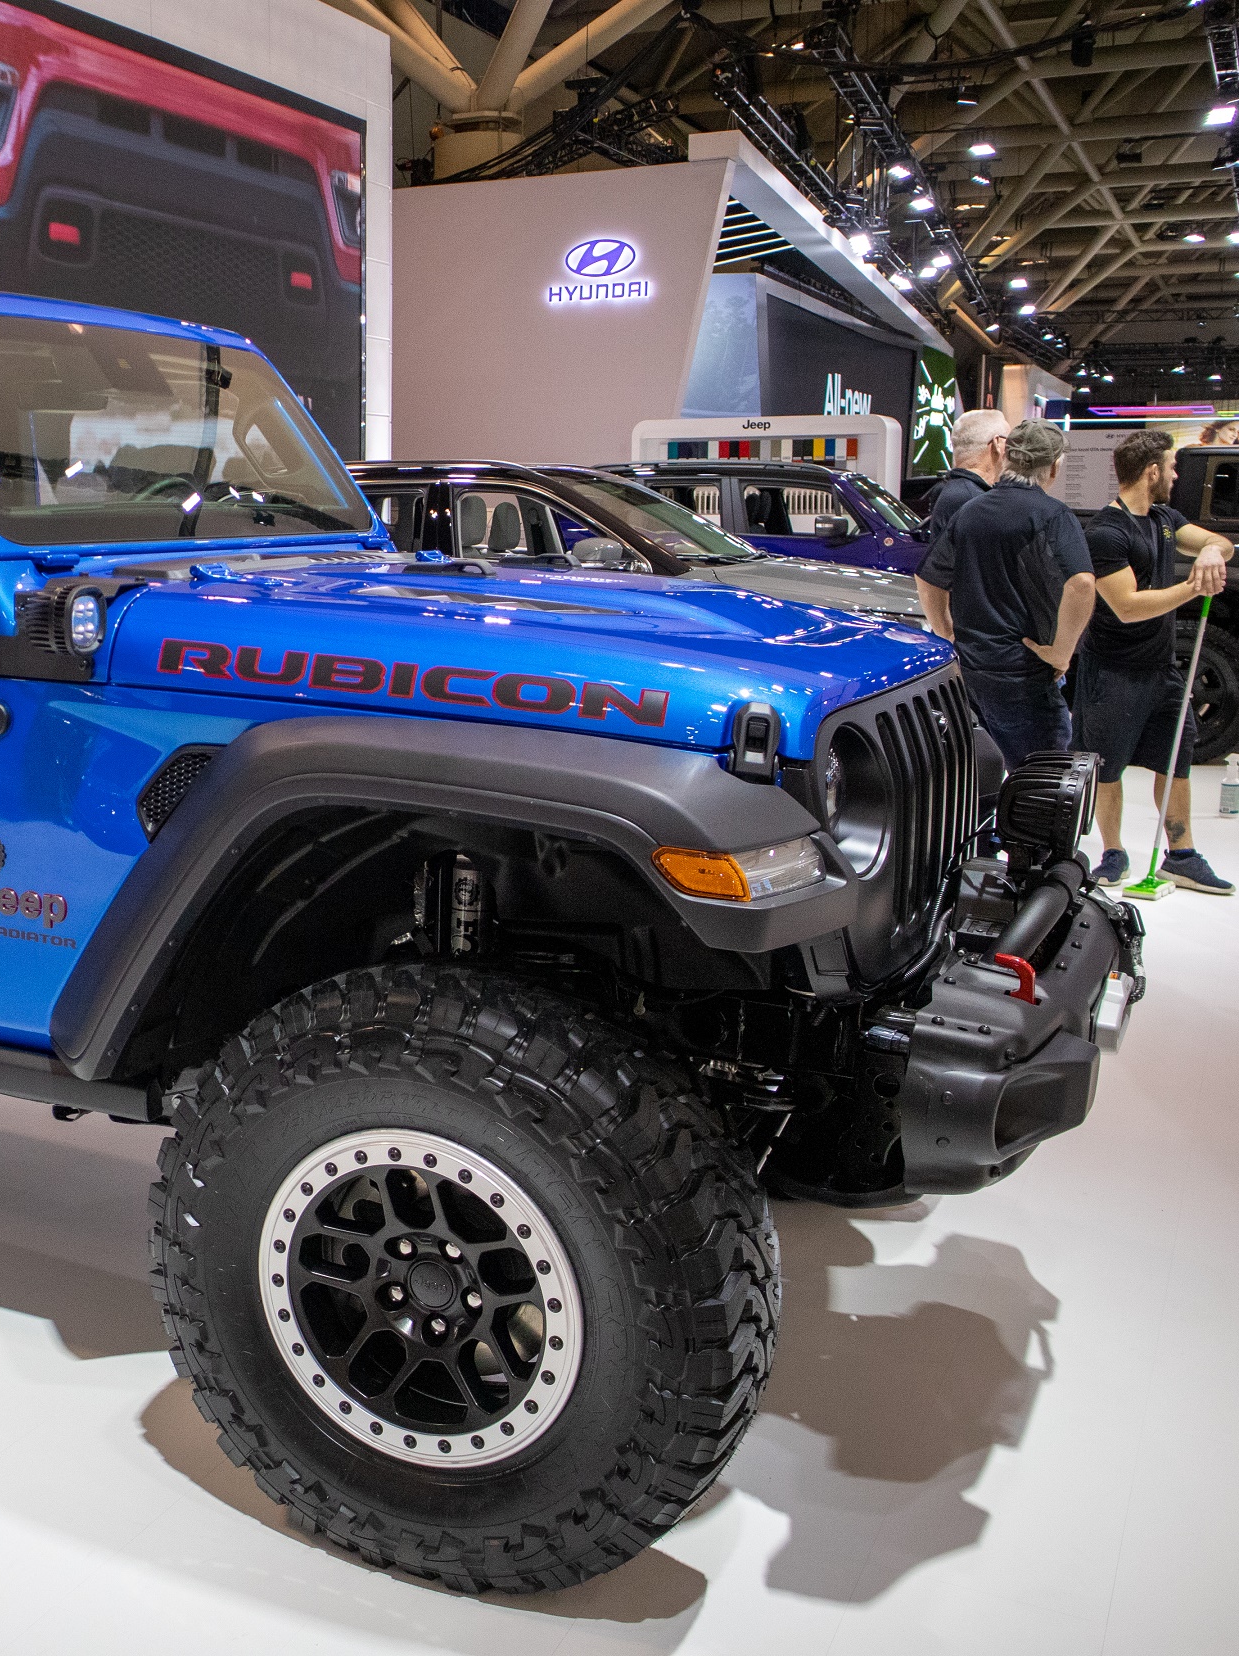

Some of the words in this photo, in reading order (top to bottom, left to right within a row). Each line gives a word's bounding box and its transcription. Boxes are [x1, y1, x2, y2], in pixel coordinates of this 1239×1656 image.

[548, 281, 649, 302] HYUNDAI
[824, 373, 872, 416] All-new
[742, 419, 771, 431] Jeep
[157, 638, 670, 727] RUBICON
